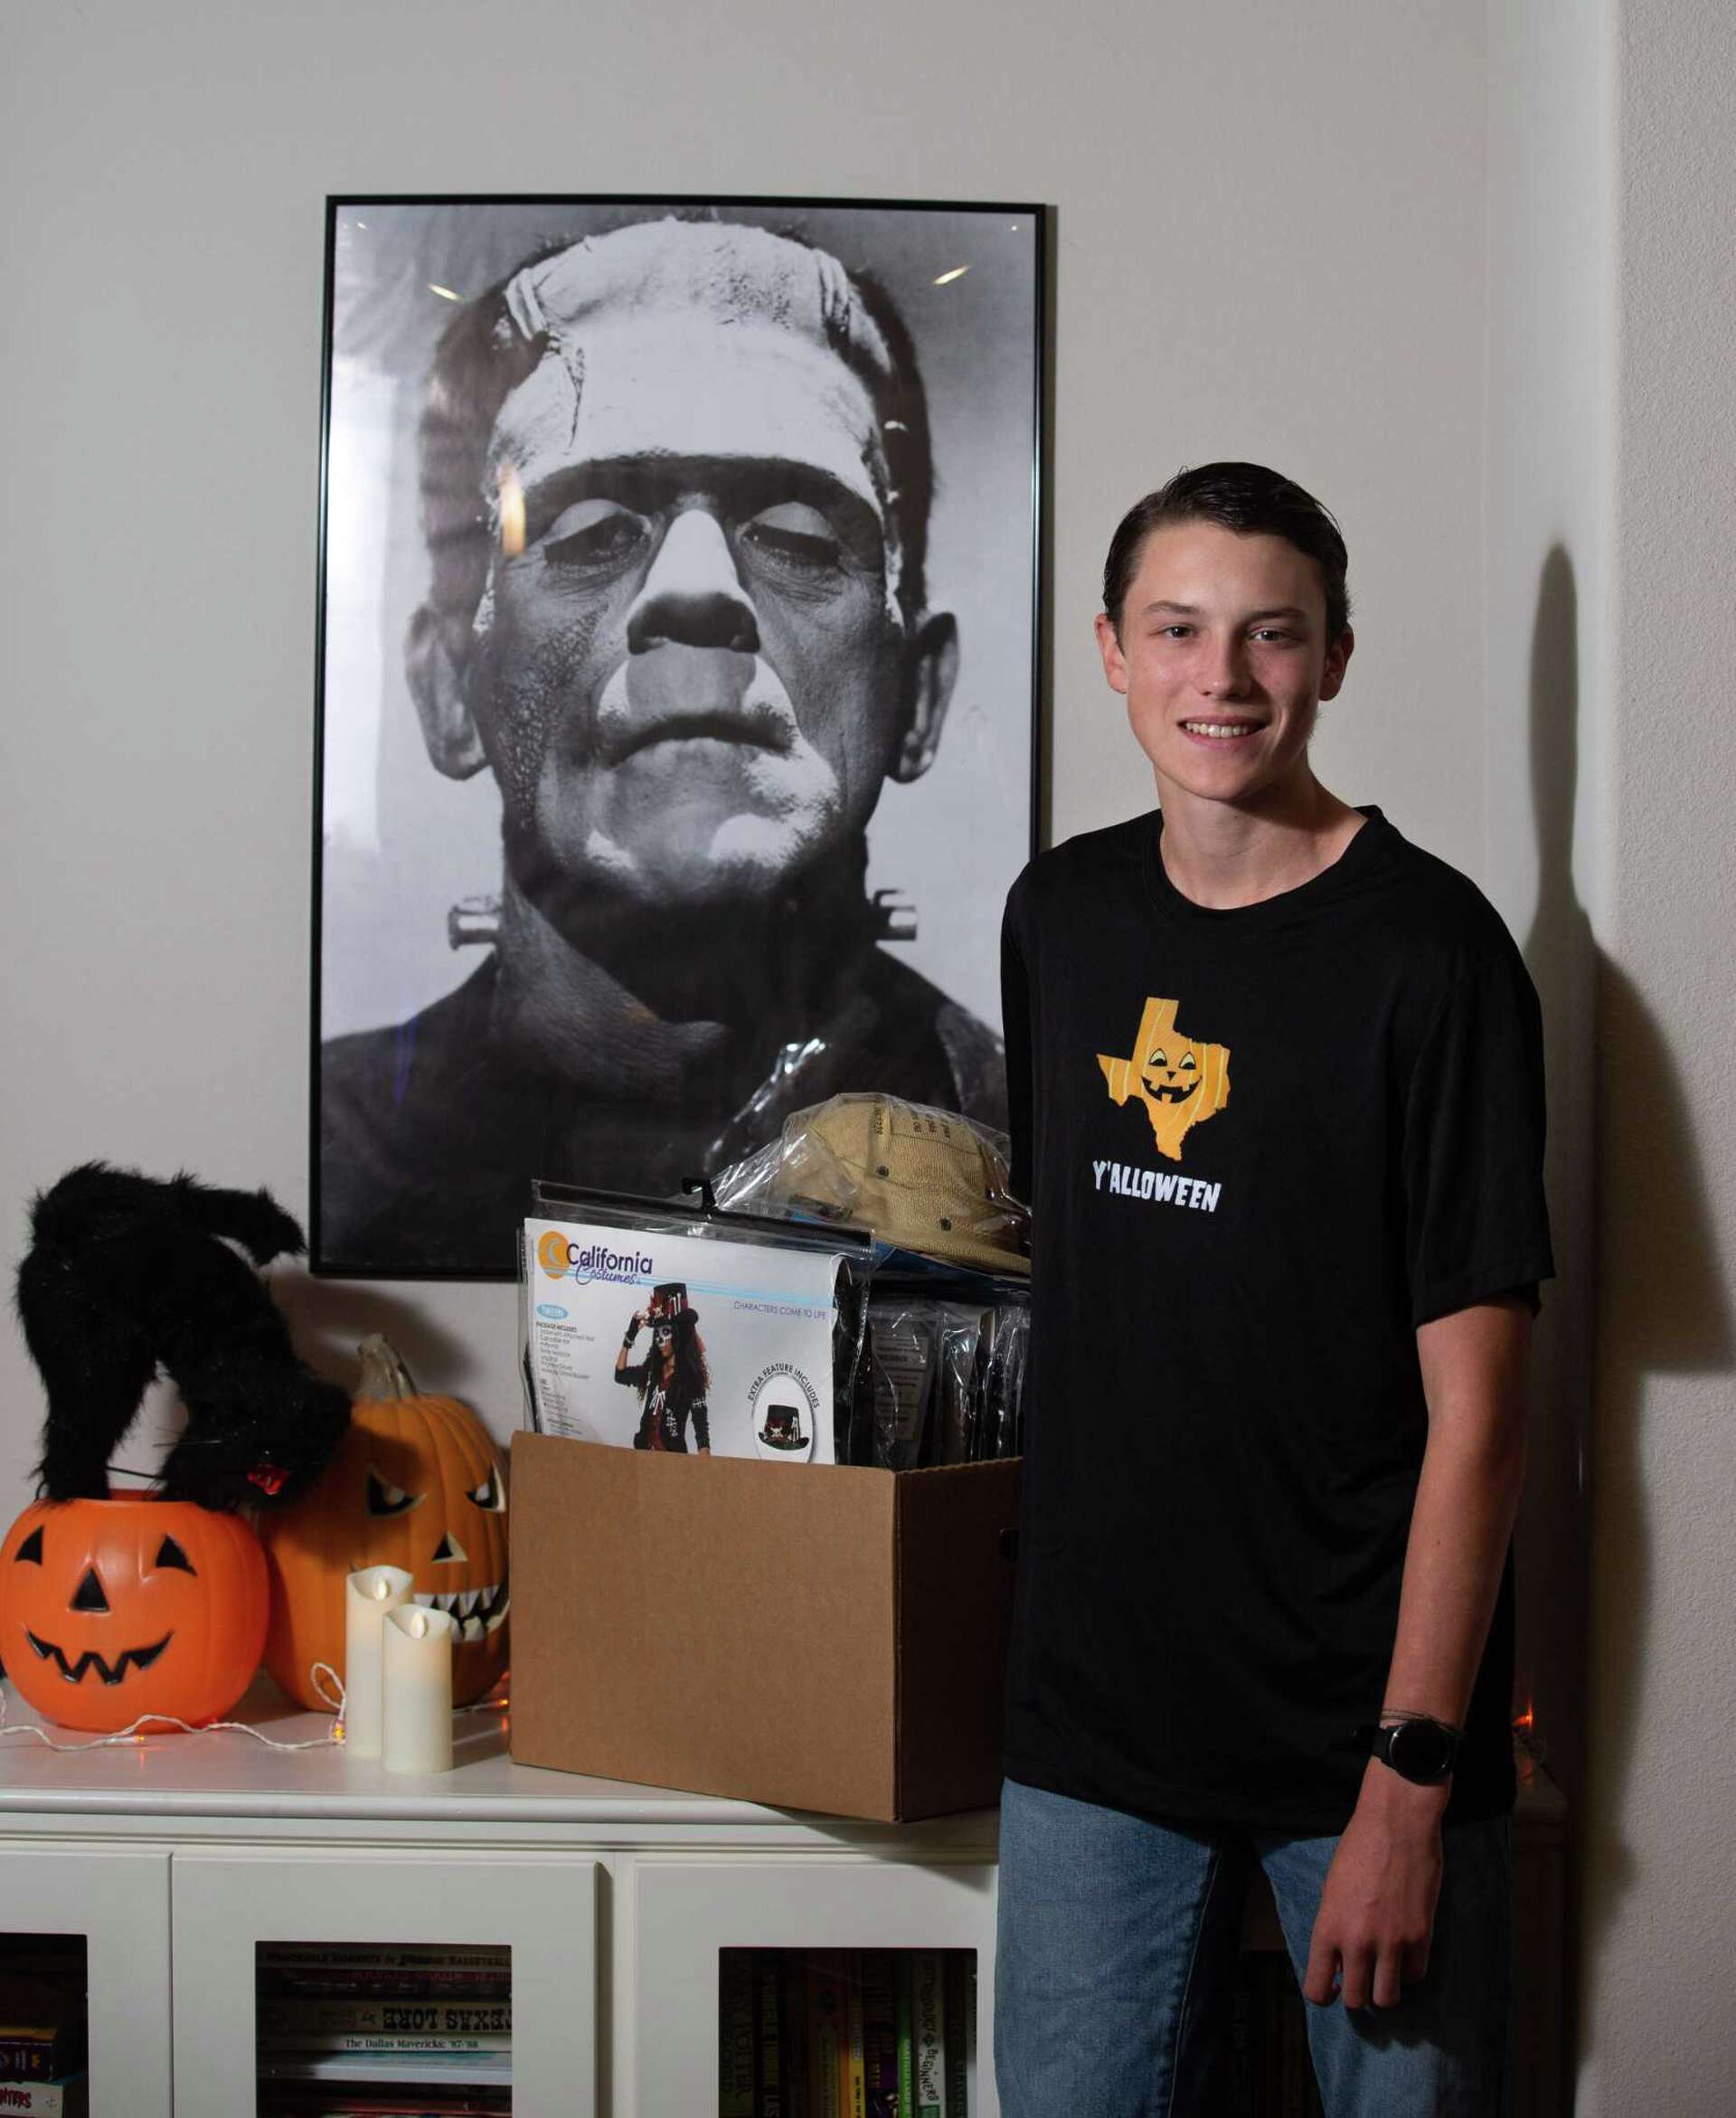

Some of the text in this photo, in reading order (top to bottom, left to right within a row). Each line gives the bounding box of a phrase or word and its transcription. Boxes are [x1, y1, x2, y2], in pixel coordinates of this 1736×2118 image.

[1092, 1160, 1222, 1213] Y'ALLOWEEN
[566, 1243, 653, 1274] California
[576, 1258, 637, 1285] Costumes
[734, 1300, 826, 1319] CHARACTERS COME TO LIFE
[747, 1362, 820, 1408] EXTRA FEATURE INCLUDES
[382, 2007, 439, 2030] LORE
[346, 2038, 363, 2048] The
[365, 2038, 395, 2048] Dallas
[920, 2048, 940, 2102] BEGINNERS
